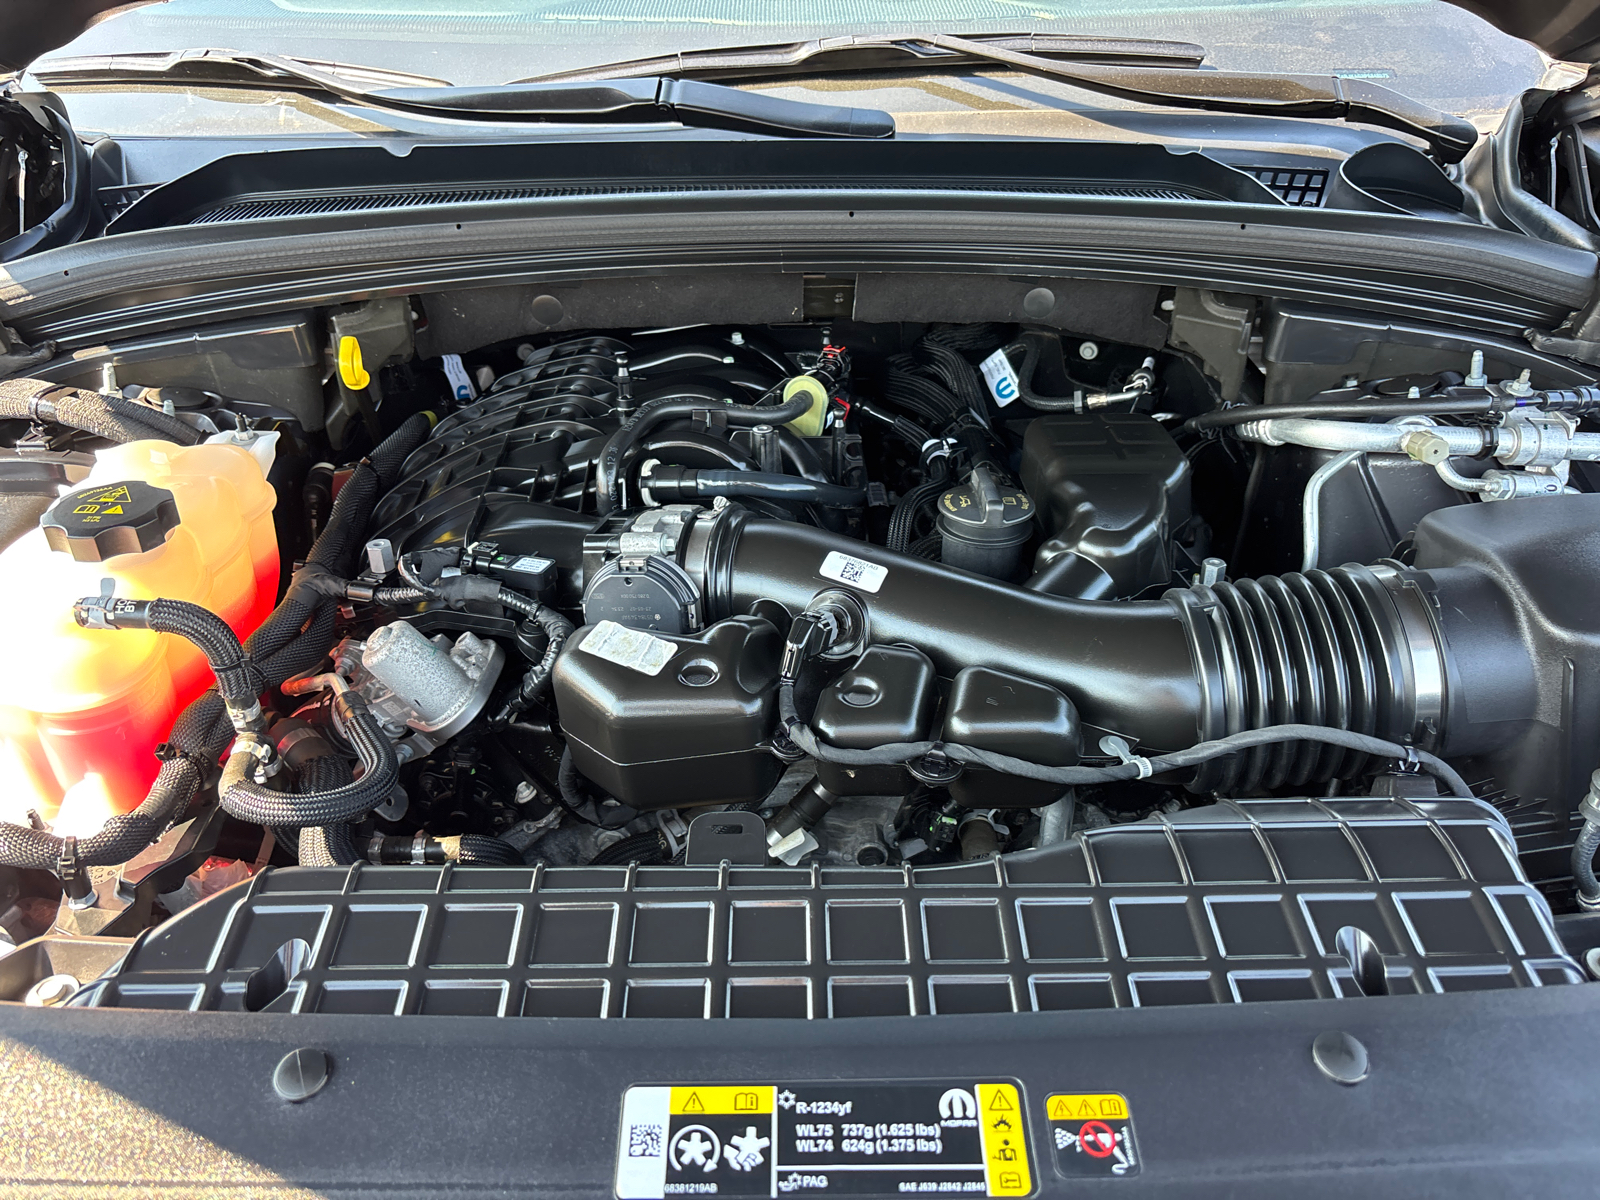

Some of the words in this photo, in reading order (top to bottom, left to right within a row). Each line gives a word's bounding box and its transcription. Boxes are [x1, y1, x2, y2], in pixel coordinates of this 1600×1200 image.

[795, 1101, 853, 1116] R-1234yf
[939, 1119, 978, 1127] MOPAR
[795, 1123, 835, 1137] WL75
[841, 1123, 874, 1139] 737g
[874, 1123, 915, 1138] (1.625
[915, 1123, 941, 1138] lbs)
[795, 1138, 835, 1153] WL74
[841, 1139, 875, 1155] 624g
[875, 1138, 915, 1154] (1.375
[916, 1138, 943, 1154] lbs)
[664, 1182, 718, 1194] 68381219AB
[803, 1175, 829, 1188] PAG
[898, 1181, 917, 1192] SAE
